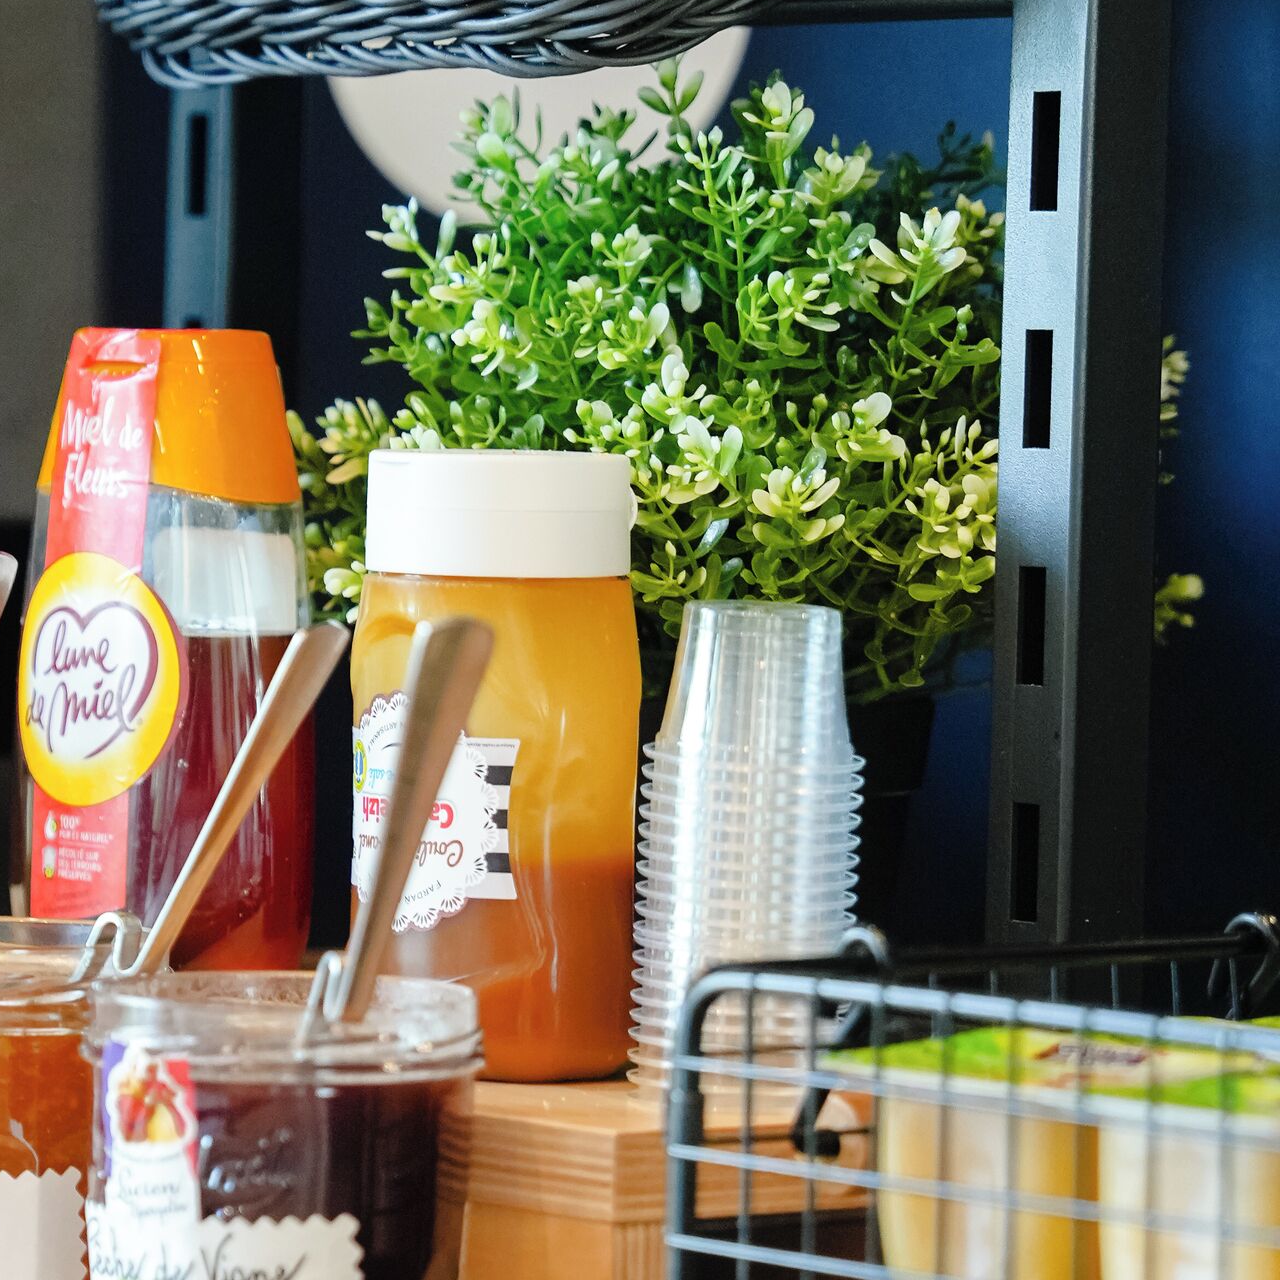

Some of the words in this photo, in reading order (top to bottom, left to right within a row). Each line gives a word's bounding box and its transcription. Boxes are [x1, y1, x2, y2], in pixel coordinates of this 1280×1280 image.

[61, 396, 115, 451] Miel
[119, 414, 143, 451] de
[62, 452, 128, 508] Fleurs
[26, 688, 44, 730] de
[415, 840, 464, 867] Couli
